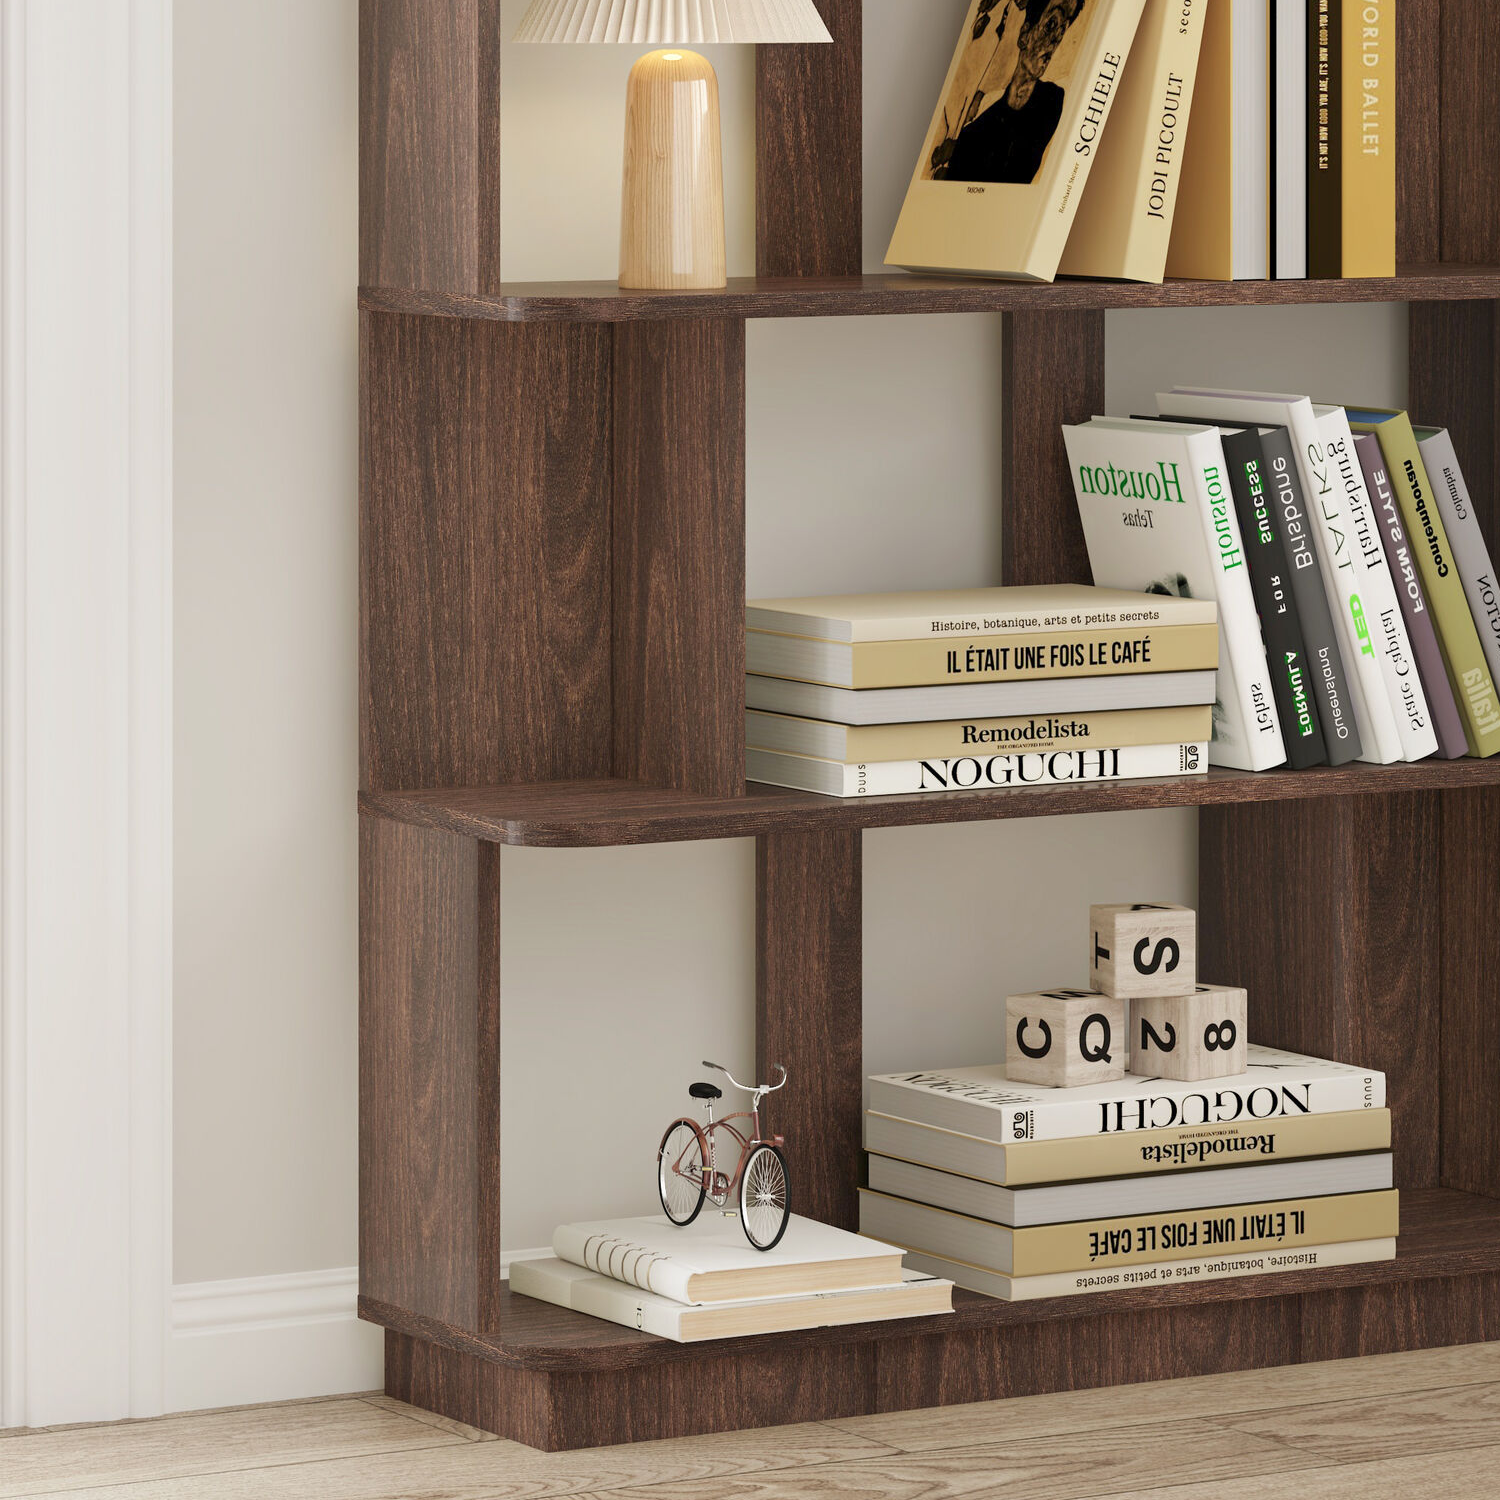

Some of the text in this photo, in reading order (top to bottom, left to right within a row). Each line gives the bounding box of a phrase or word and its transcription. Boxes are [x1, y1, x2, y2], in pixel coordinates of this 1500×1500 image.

[1075, 52, 1121, 156] SCHIELE
[1363, 78, 1379, 156] BALLET
[1147, 72, 1184, 220] JODI PICOULT
[931, 610, 1159, 632] Histoire, botanique, arts et petits secrets
[947, 636, 1151, 674] IL ÉTAIT UNE FOIS LE CAFÉ
[961, 719, 1090, 744] Remodelista
[918, 748, 1121, 789] NOGUCHI
[1016, 1016, 1052, 1059] C
[1098, 1083, 1312, 1133] NOGUCHI
[1364, 1077, 1372, 1107] DUUS
[1141, 1134, 1276, 1163] Remodelista
[1076, 1253, 1317, 1287] Histoire, botanique, arts et petits secrets
